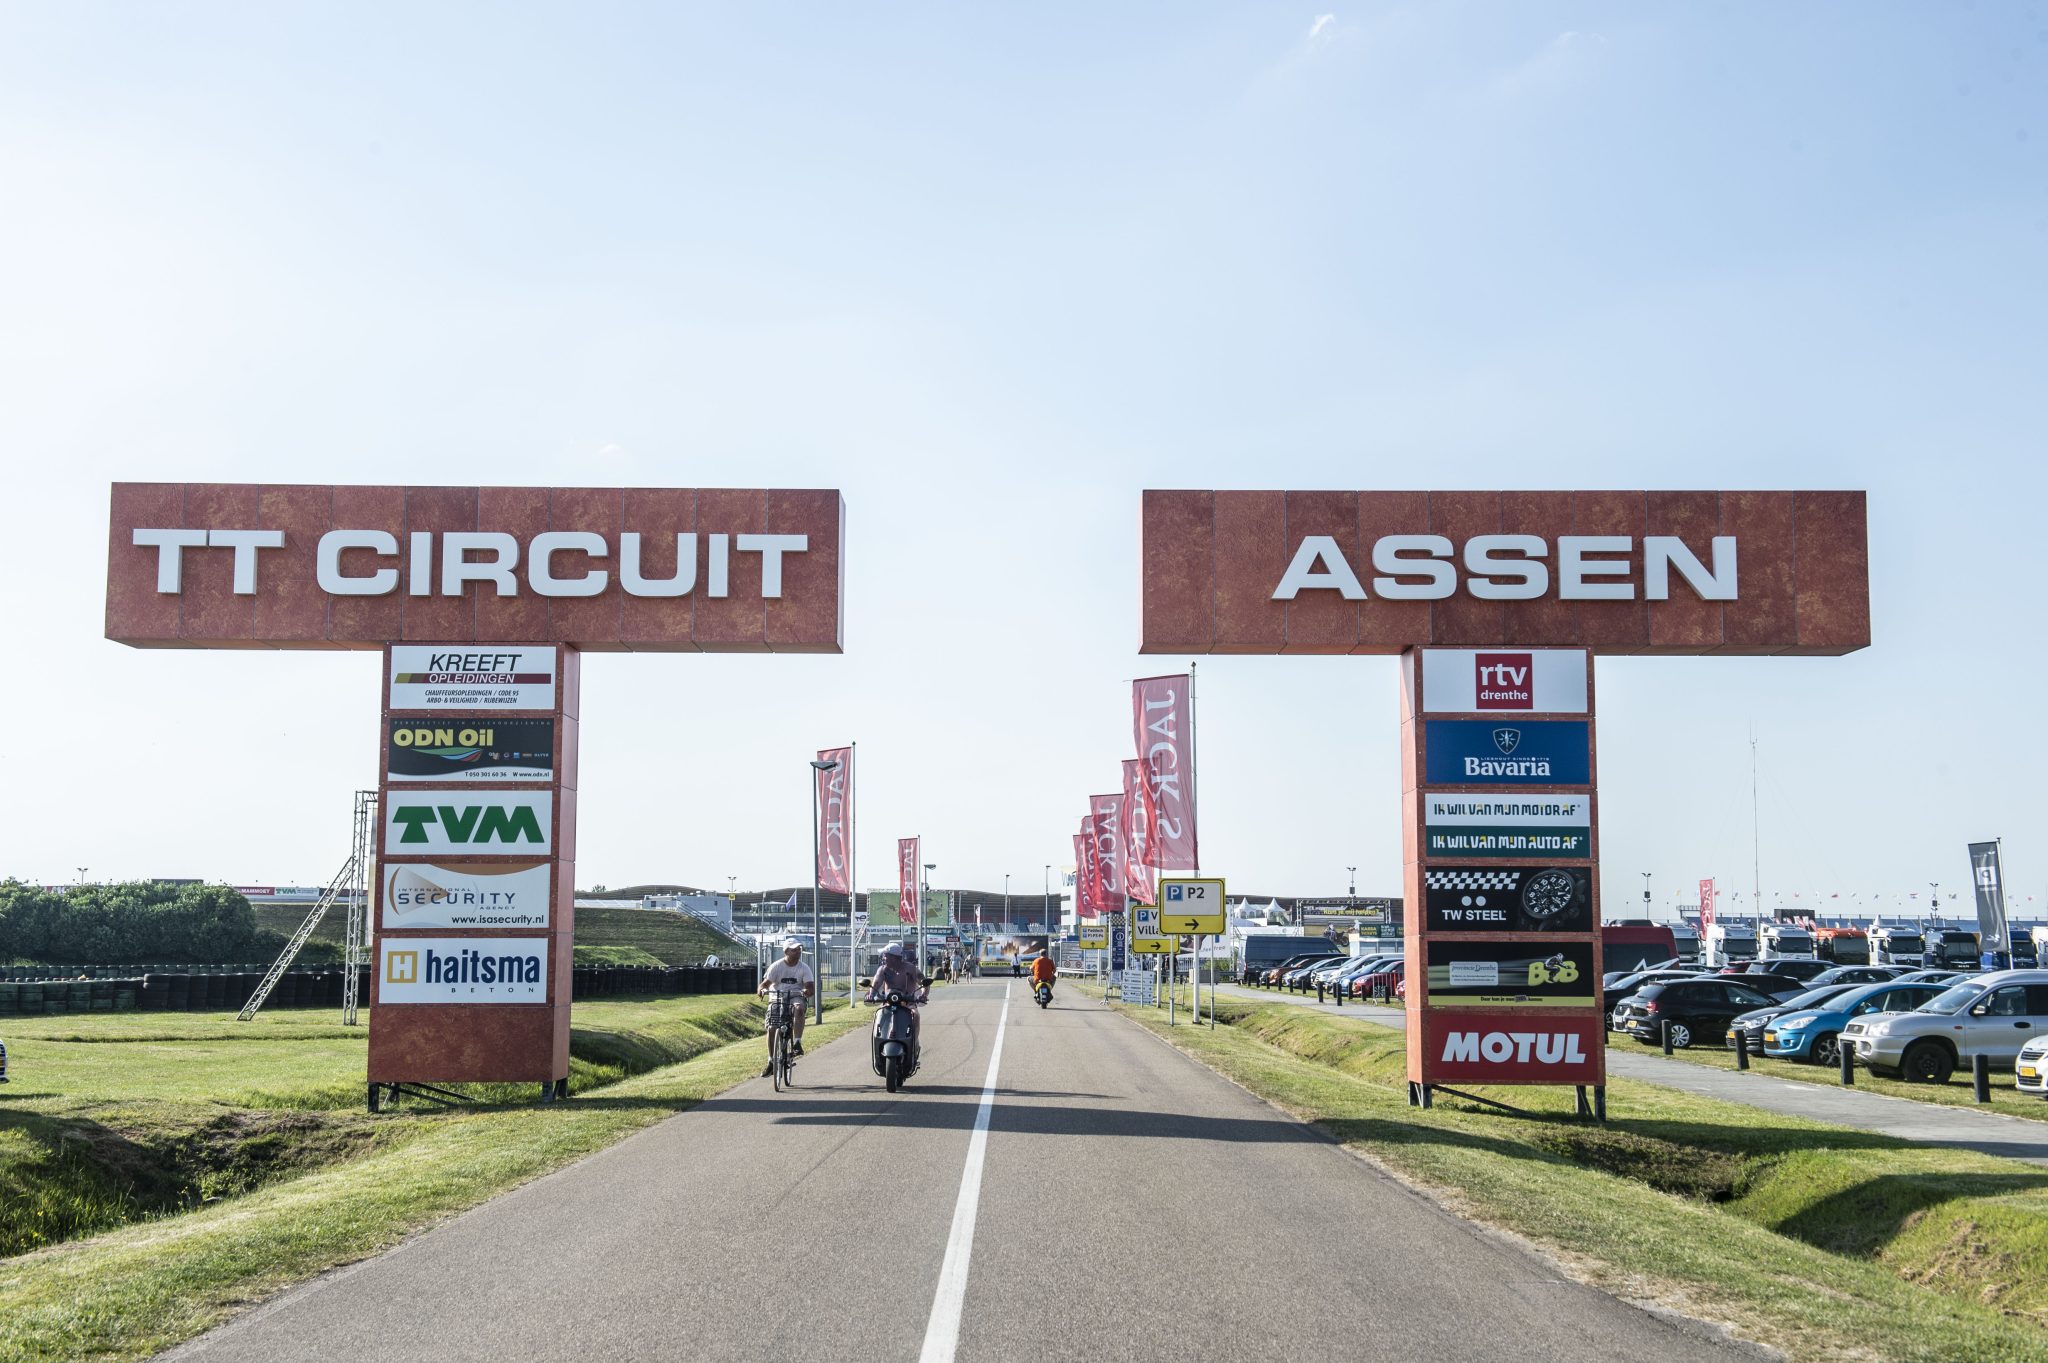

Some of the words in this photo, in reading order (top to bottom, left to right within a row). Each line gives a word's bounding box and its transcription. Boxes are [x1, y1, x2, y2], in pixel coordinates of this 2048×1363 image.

[132, 528, 285, 595] TT
[316, 529, 809, 598] CIRCUIT
[1271, 534, 1739, 601] ASSEN
[429, 653, 523, 672] KREEFT
[428, 673, 516, 684] OPLEIDINGEN
[1480, 663, 1528, 686] rtv
[424, 689, 493, 697] CHAUFFEURSOPLEIDINGEN
[1480, 690, 1528, 700] drenthe
[393, 728, 454, 747] ODN
[458, 729, 494, 747] Oil
[1464, 756, 1551, 776] Bavaria
[1434, 803, 1446, 816] IK
[1446, 803, 1468, 816] WIL
[1468, 803, 1492, 816] VAN
[1493, 804, 1520, 816] MIJN
[1521, 804, 1561, 816] MOTOR
[1562, 804, 1576, 816] AF
[392, 805, 545, 844] TVM
[1432, 835, 1445, 849] IK
[1446, 835, 1470, 849] WIL
[1470, 835, 1496, 849] VAN
[1498, 836, 1527, 849] MIJN
[1528, 836, 1561, 849] AUTO
[1562, 836, 1578, 850] AF
[398, 892, 516, 905] SECURITY
[1187, 886, 1205, 899] P2
[451, 914, 544, 926] www.isasecurity.nl
[1441, 909, 1463, 921] TW
[1465, 910, 1507, 921] STEEL
[425, 948, 540, 984] haitsma
[1441, 1031, 1586, 1064] MOTUL
